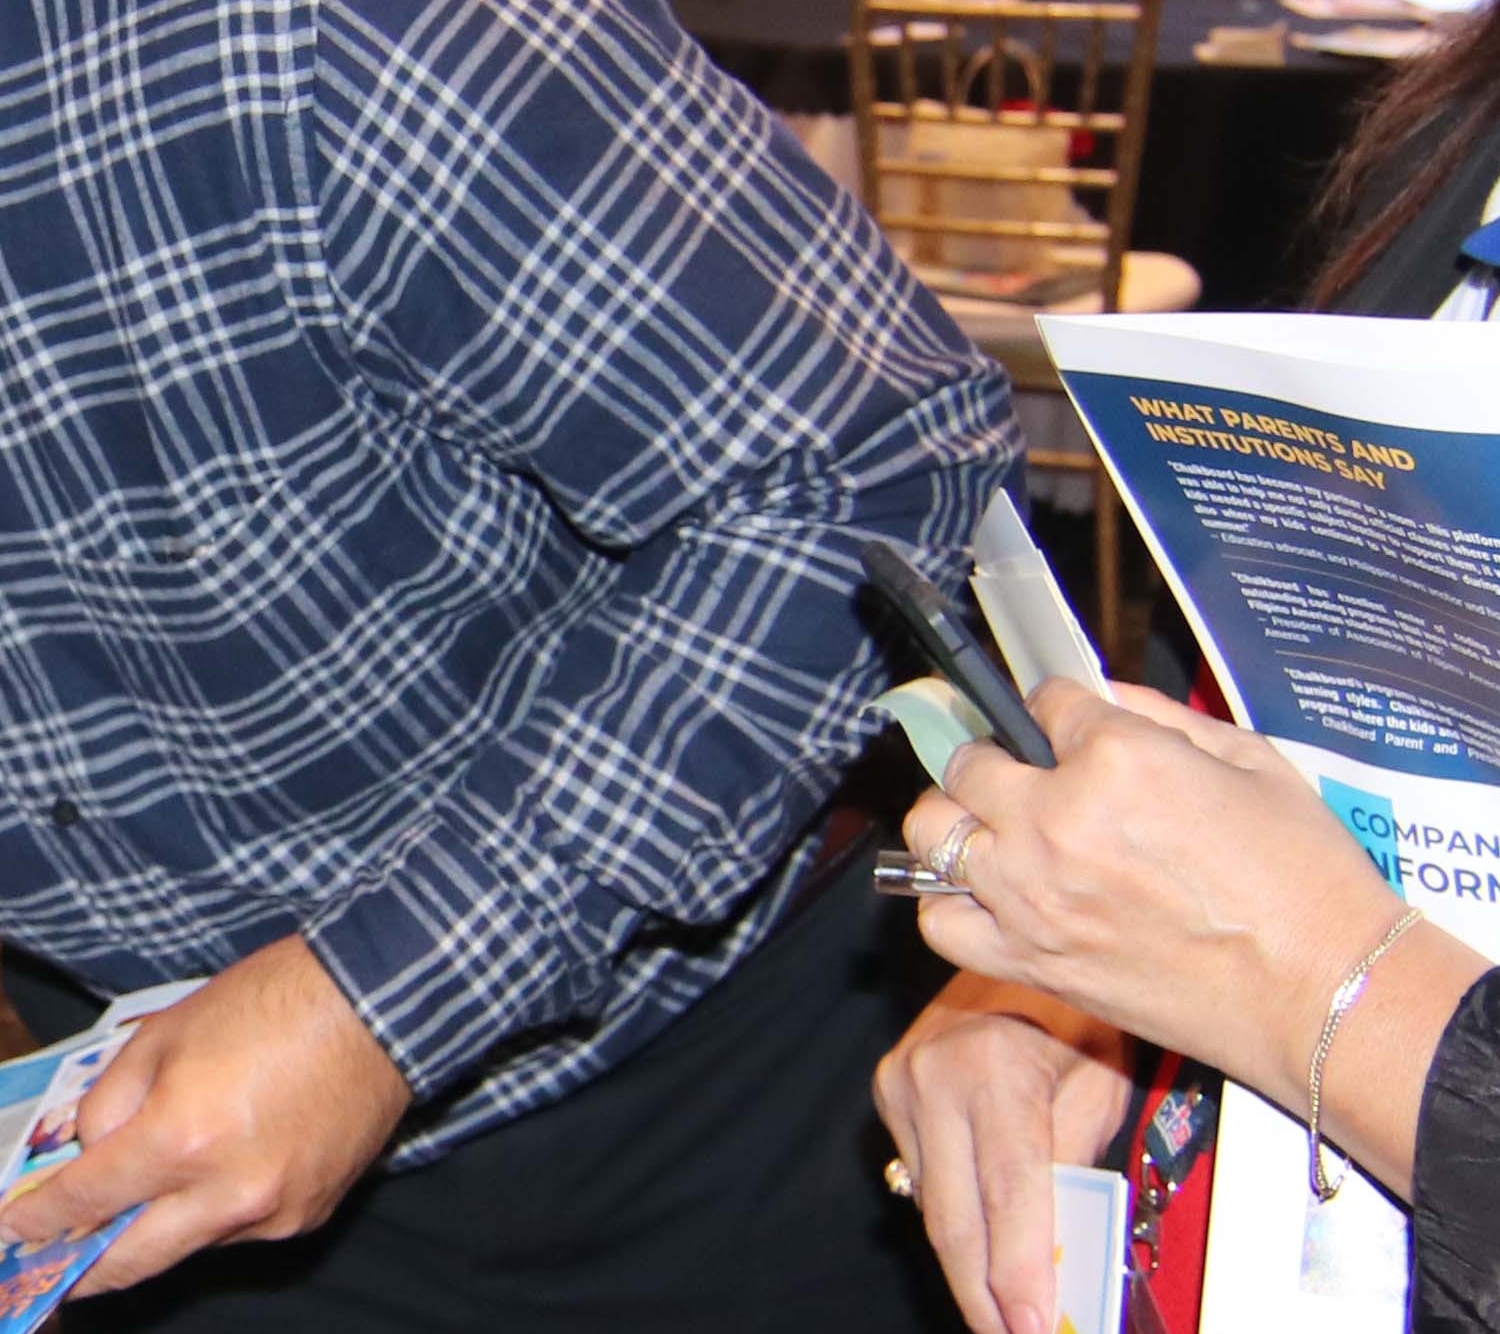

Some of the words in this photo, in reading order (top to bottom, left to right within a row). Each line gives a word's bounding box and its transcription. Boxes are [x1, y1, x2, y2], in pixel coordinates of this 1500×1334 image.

[1130, 395, 1214, 425] WHAT
[1219, 407, 1347, 455] PARENTS
[1352, 440, 1416, 473] AND
[1145, 422, 1332, 473] INSTITUTIONS
[1335, 461, 1388, 490] SAY
[1452, 544, 1492, 562] where
[1350, 709, 1385, 727] where
[1386, 716, 1408, 732] the
[1409, 718, 1436, 736] kids
[1385, 732, 1425, 750] Parent
[1433, 742, 1458, 756] and
